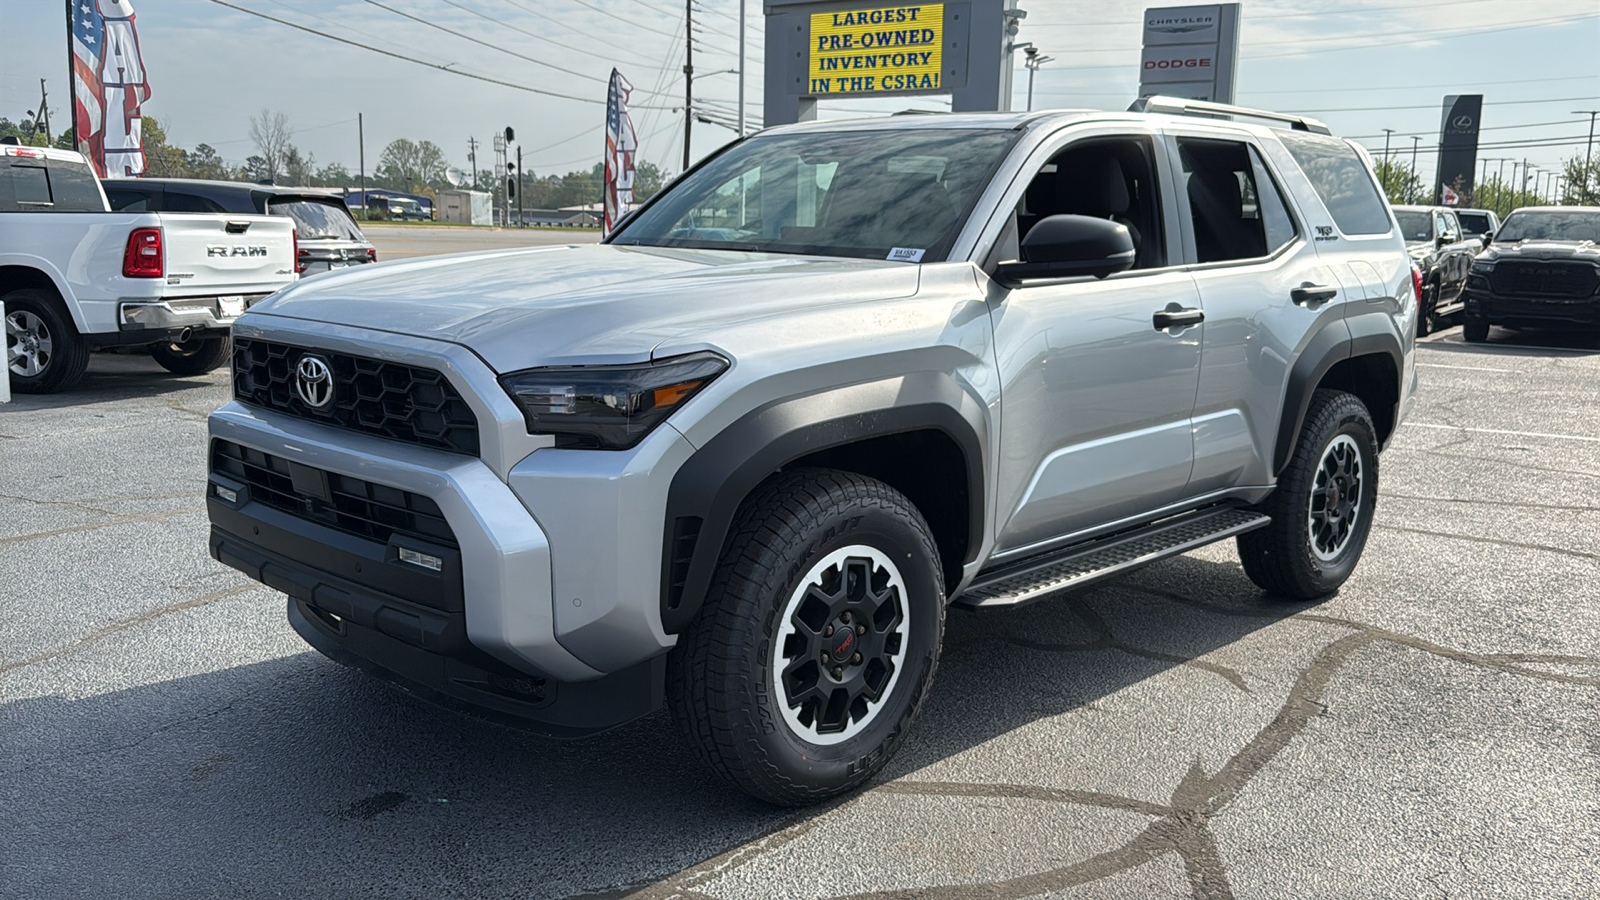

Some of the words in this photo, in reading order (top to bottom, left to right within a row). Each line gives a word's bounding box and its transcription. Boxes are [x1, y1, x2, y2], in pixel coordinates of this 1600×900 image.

[832, 8, 921, 27] LARGEST
[1148, 17, 1212, 26] CHRYSLER
[818, 29, 935, 49] PRE-OWNED
[819, 52, 932, 71] INVENTORY
[1144, 58, 1211, 70] DODGE
[811, 78, 831, 92] IN
[837, 76, 875, 92] THE
[881, 73, 939, 90] CSRA!
[207, 245, 267, 257] RAM
[834, 632, 853, 653] TRD
